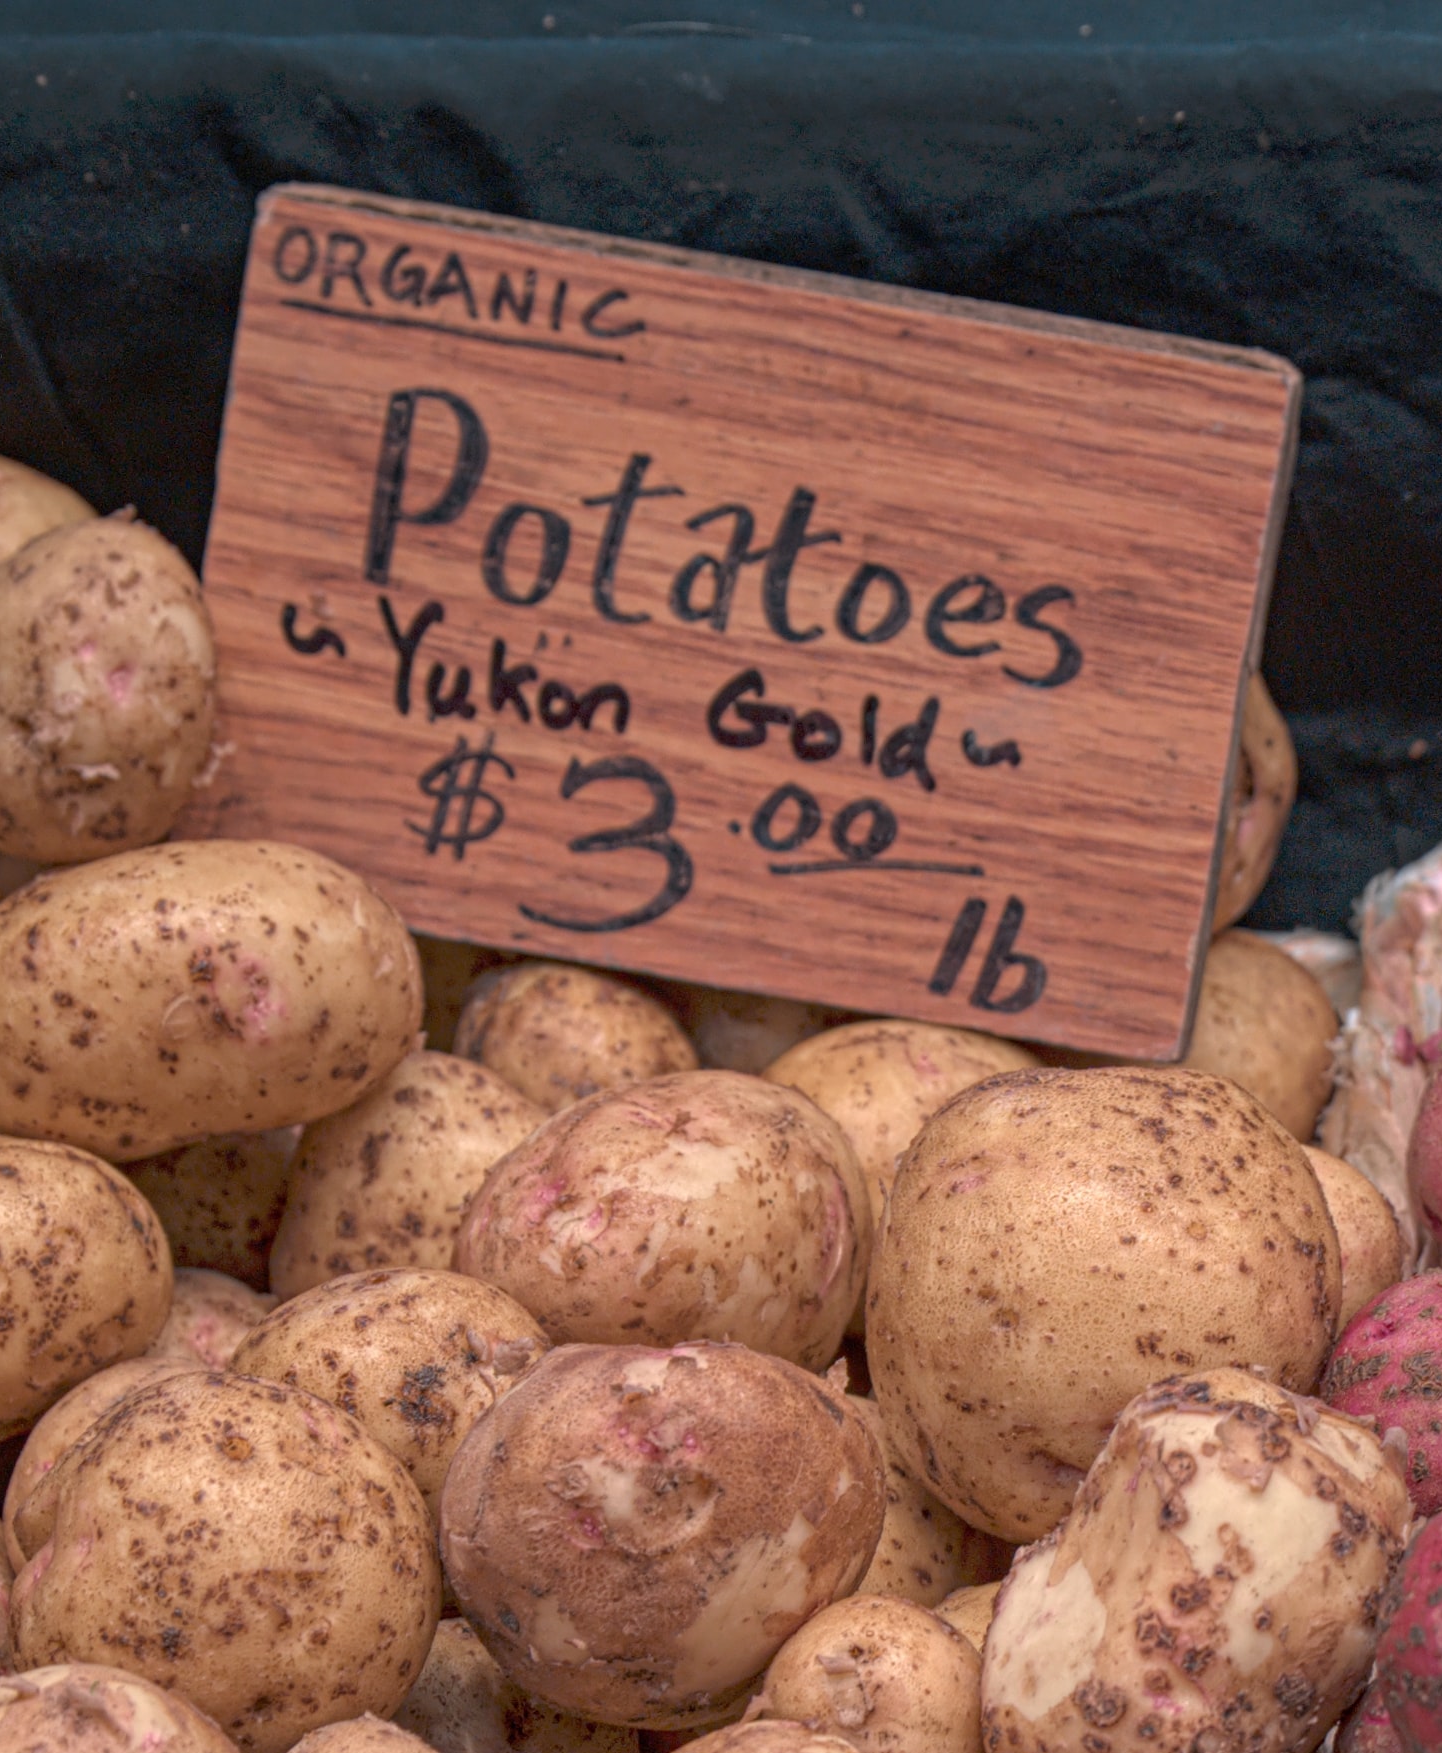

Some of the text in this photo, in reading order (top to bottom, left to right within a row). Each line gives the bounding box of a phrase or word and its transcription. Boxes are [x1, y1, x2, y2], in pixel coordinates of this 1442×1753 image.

[269, 222, 647, 340] ORGANIC
[362, 386, 1085, 690] Potatoes
[706, 667, 940, 792] Gold
[403, 730, 899, 933] $3.00
[925, 893, 1049, 1015] lb
